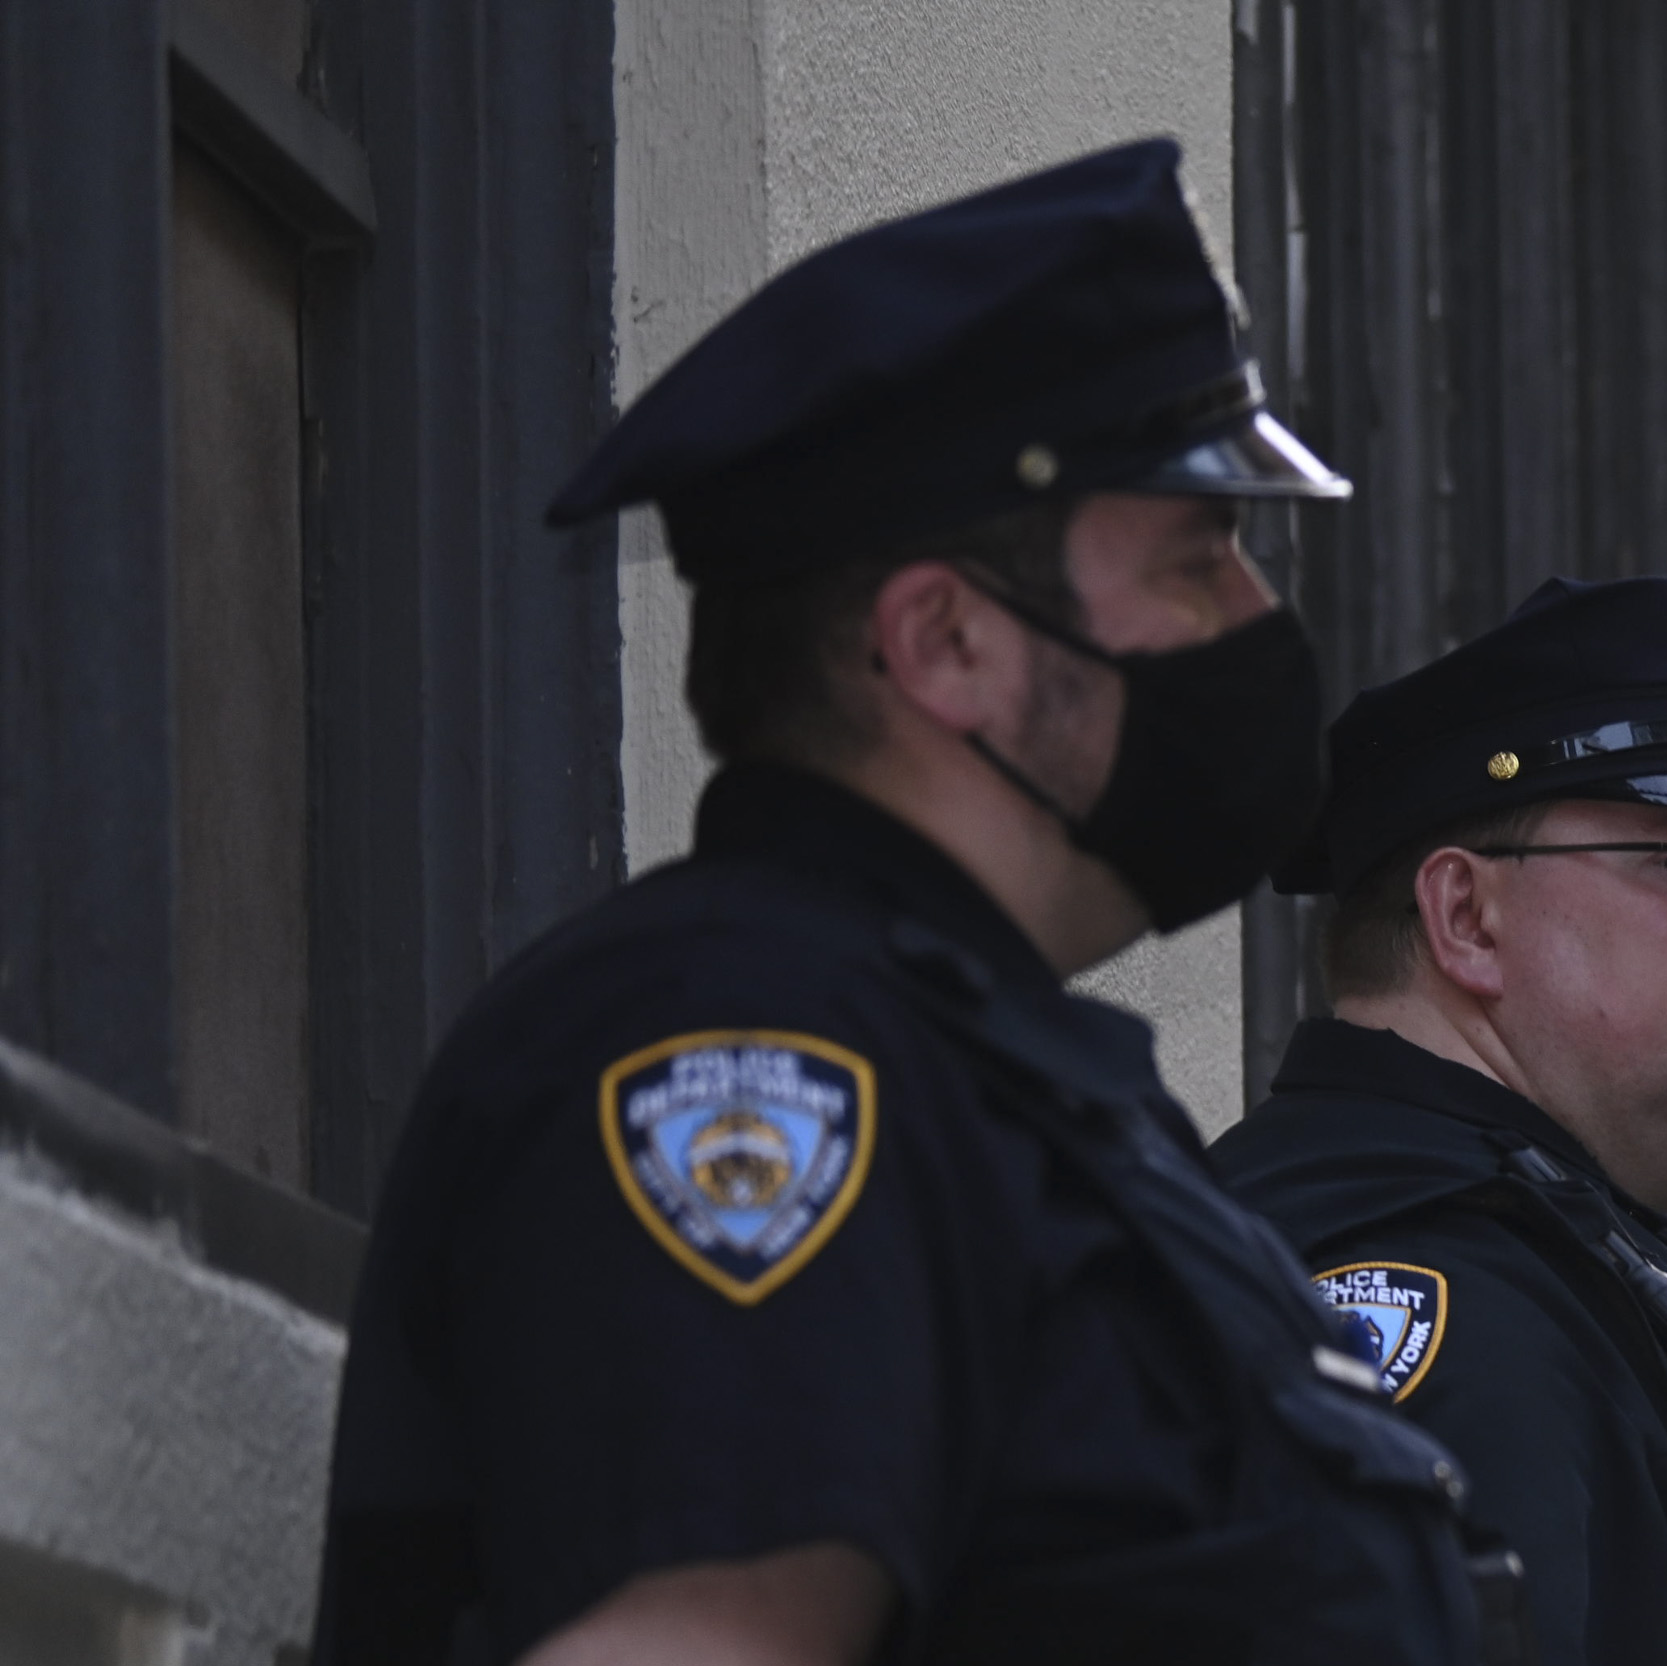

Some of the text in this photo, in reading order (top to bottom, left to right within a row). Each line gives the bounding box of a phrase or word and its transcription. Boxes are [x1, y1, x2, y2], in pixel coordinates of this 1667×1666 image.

[1316, 1270, 1388, 1293] OLICE
[1324, 1287, 1425, 1310] RTMENT
[1390, 1320, 1431, 1374] YORK
